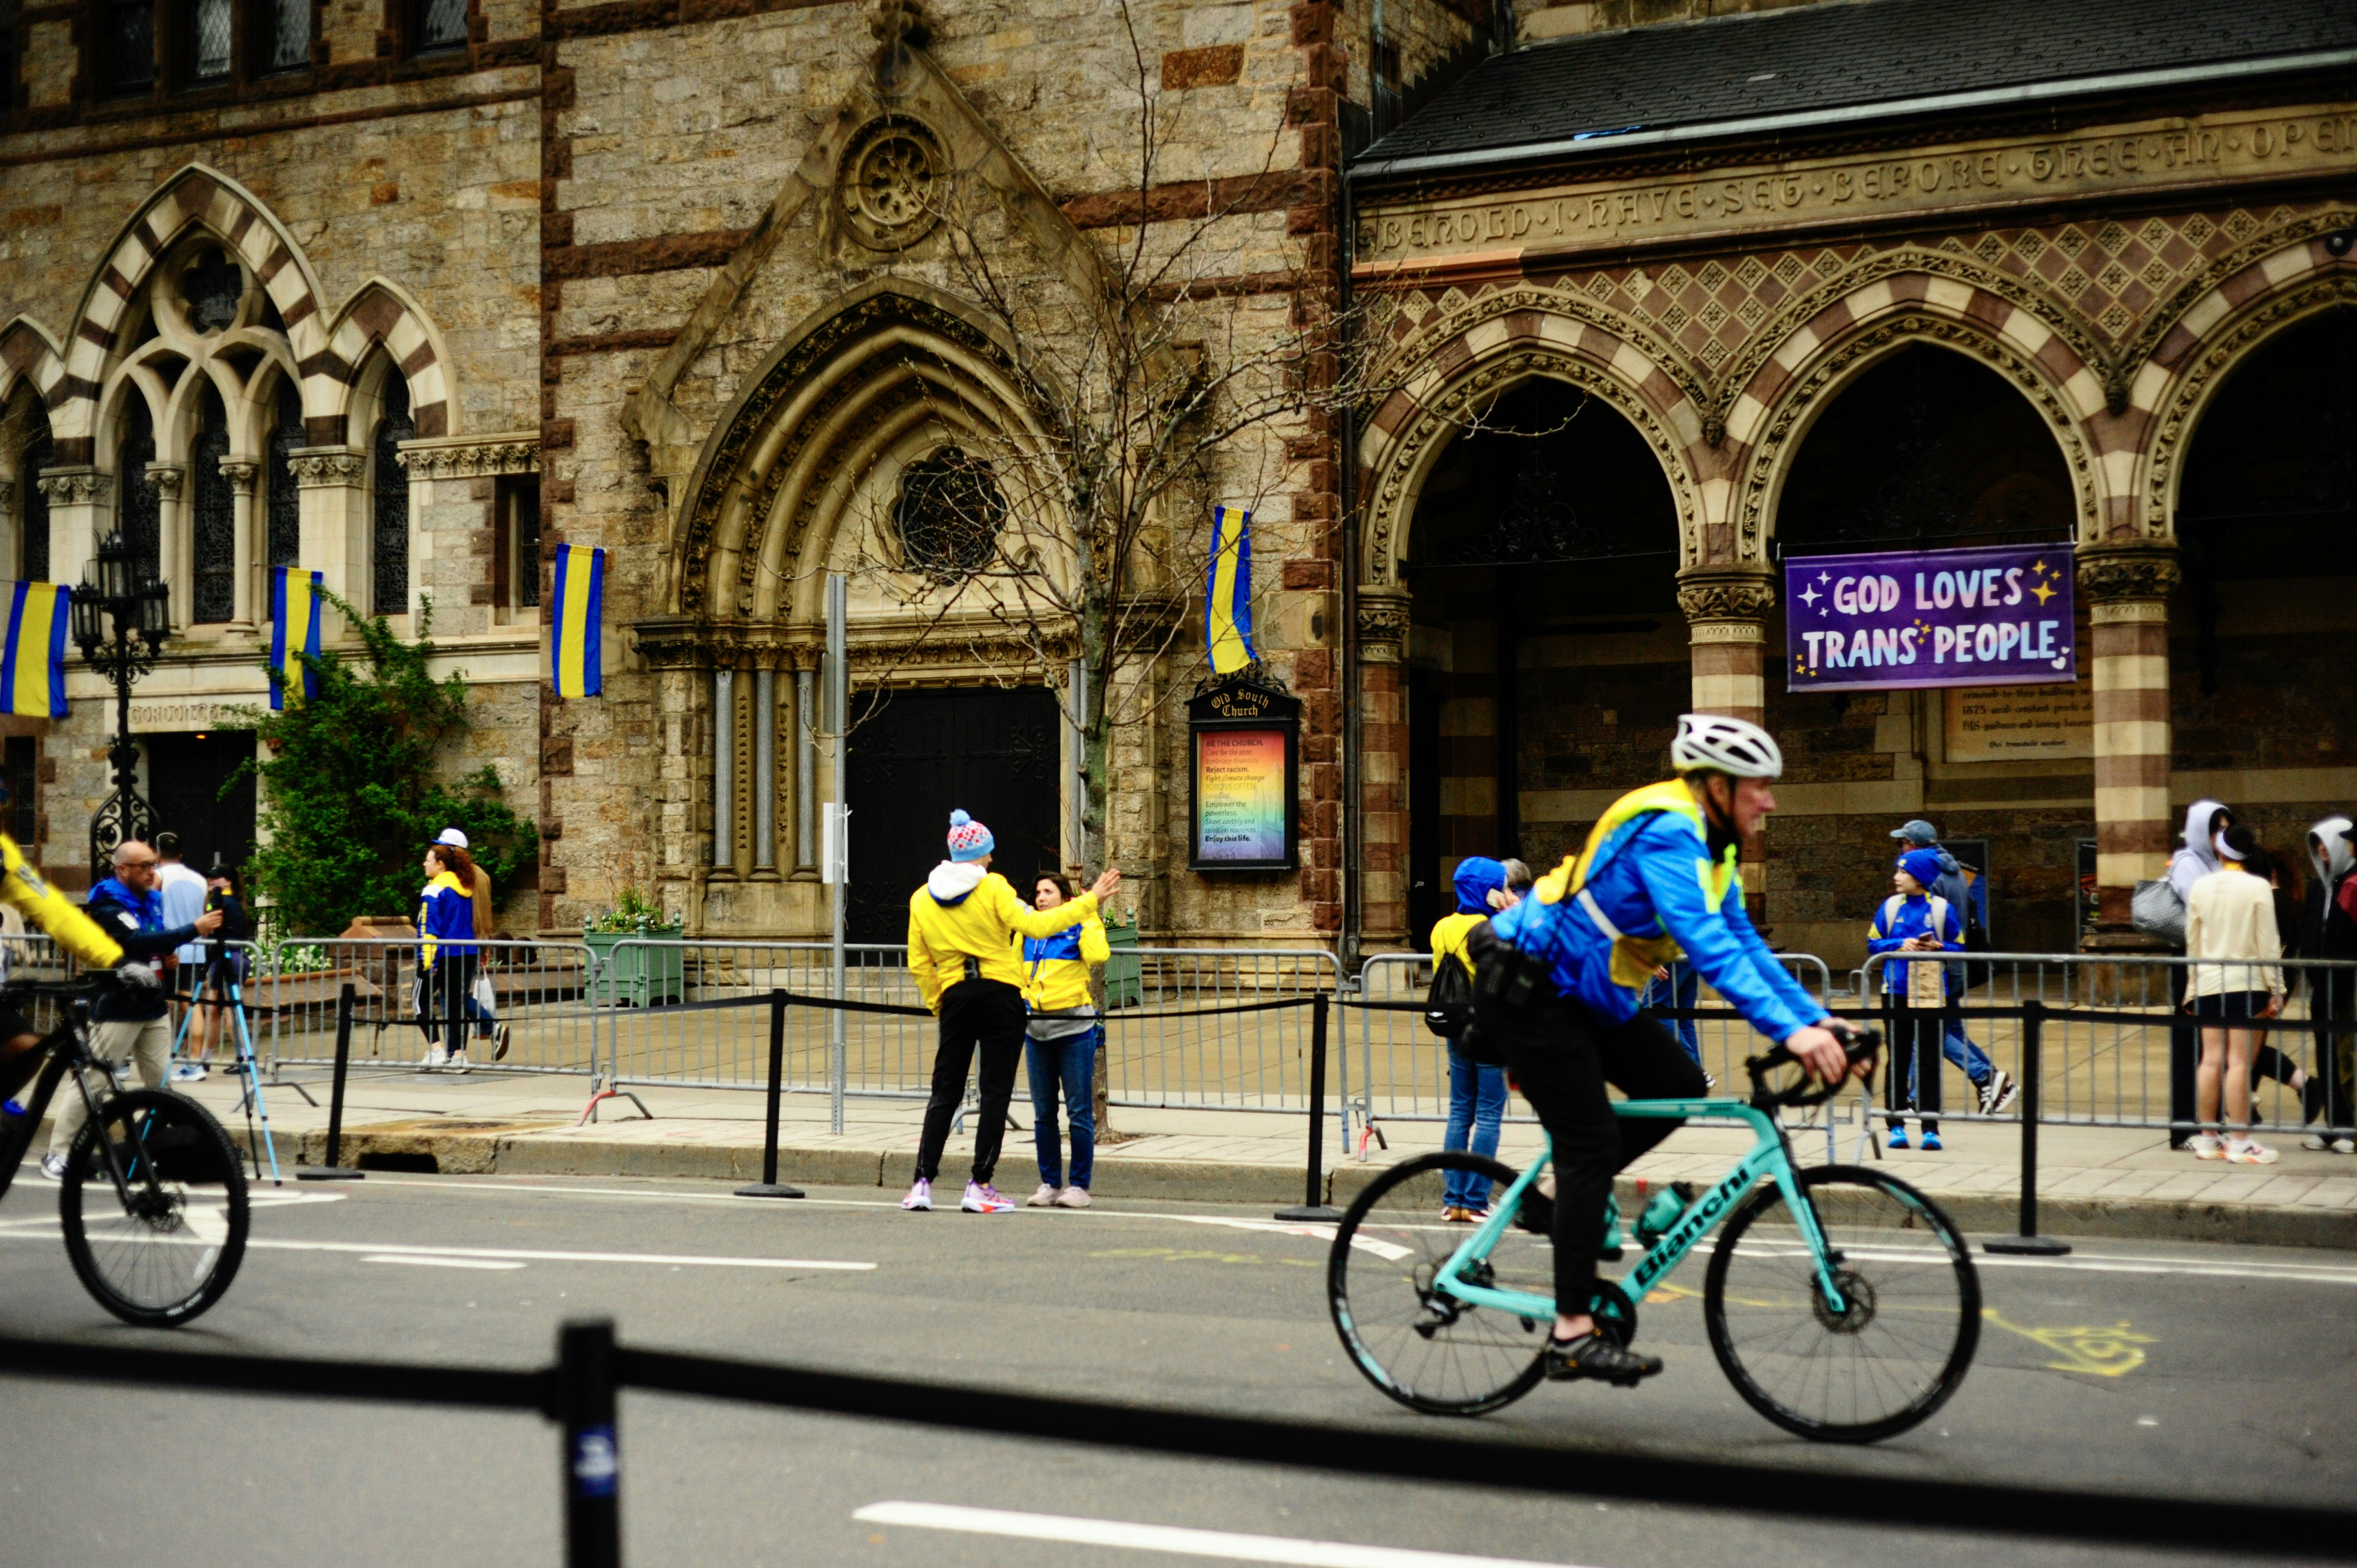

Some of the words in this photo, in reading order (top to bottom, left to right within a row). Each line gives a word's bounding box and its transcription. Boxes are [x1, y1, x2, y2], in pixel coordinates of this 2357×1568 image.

[1381, 206, 1532, 252] BEHOLD
[1553, 201, 1563, 235] I
[1585, 185, 1701, 228] HAVE
[1831, 151, 2003, 204] BEFORE
[2164, 126, 2220, 168] AN
[1833, 575, 1901, 615] GOD
[1915, 568, 2024, 610] LOVES
[1802, 627, 1918, 668] TRANS
[1934, 620, 2060, 663] PEOPLE
[1211, 693, 1231, 708] Old
[1236, 689, 1269, 709] South
[1222, 704, 1258, 718] Church
[1962, 705, 1987, 715] 1875
[1206, 775, 1221, 783] Fight
[1205, 801, 1235, 809] Empower
[1205, 809, 1238, 817] powerless.
[1205, 835, 1223, 844] Enjoy
[1634, 1167, 1751, 1287] Bianchi
